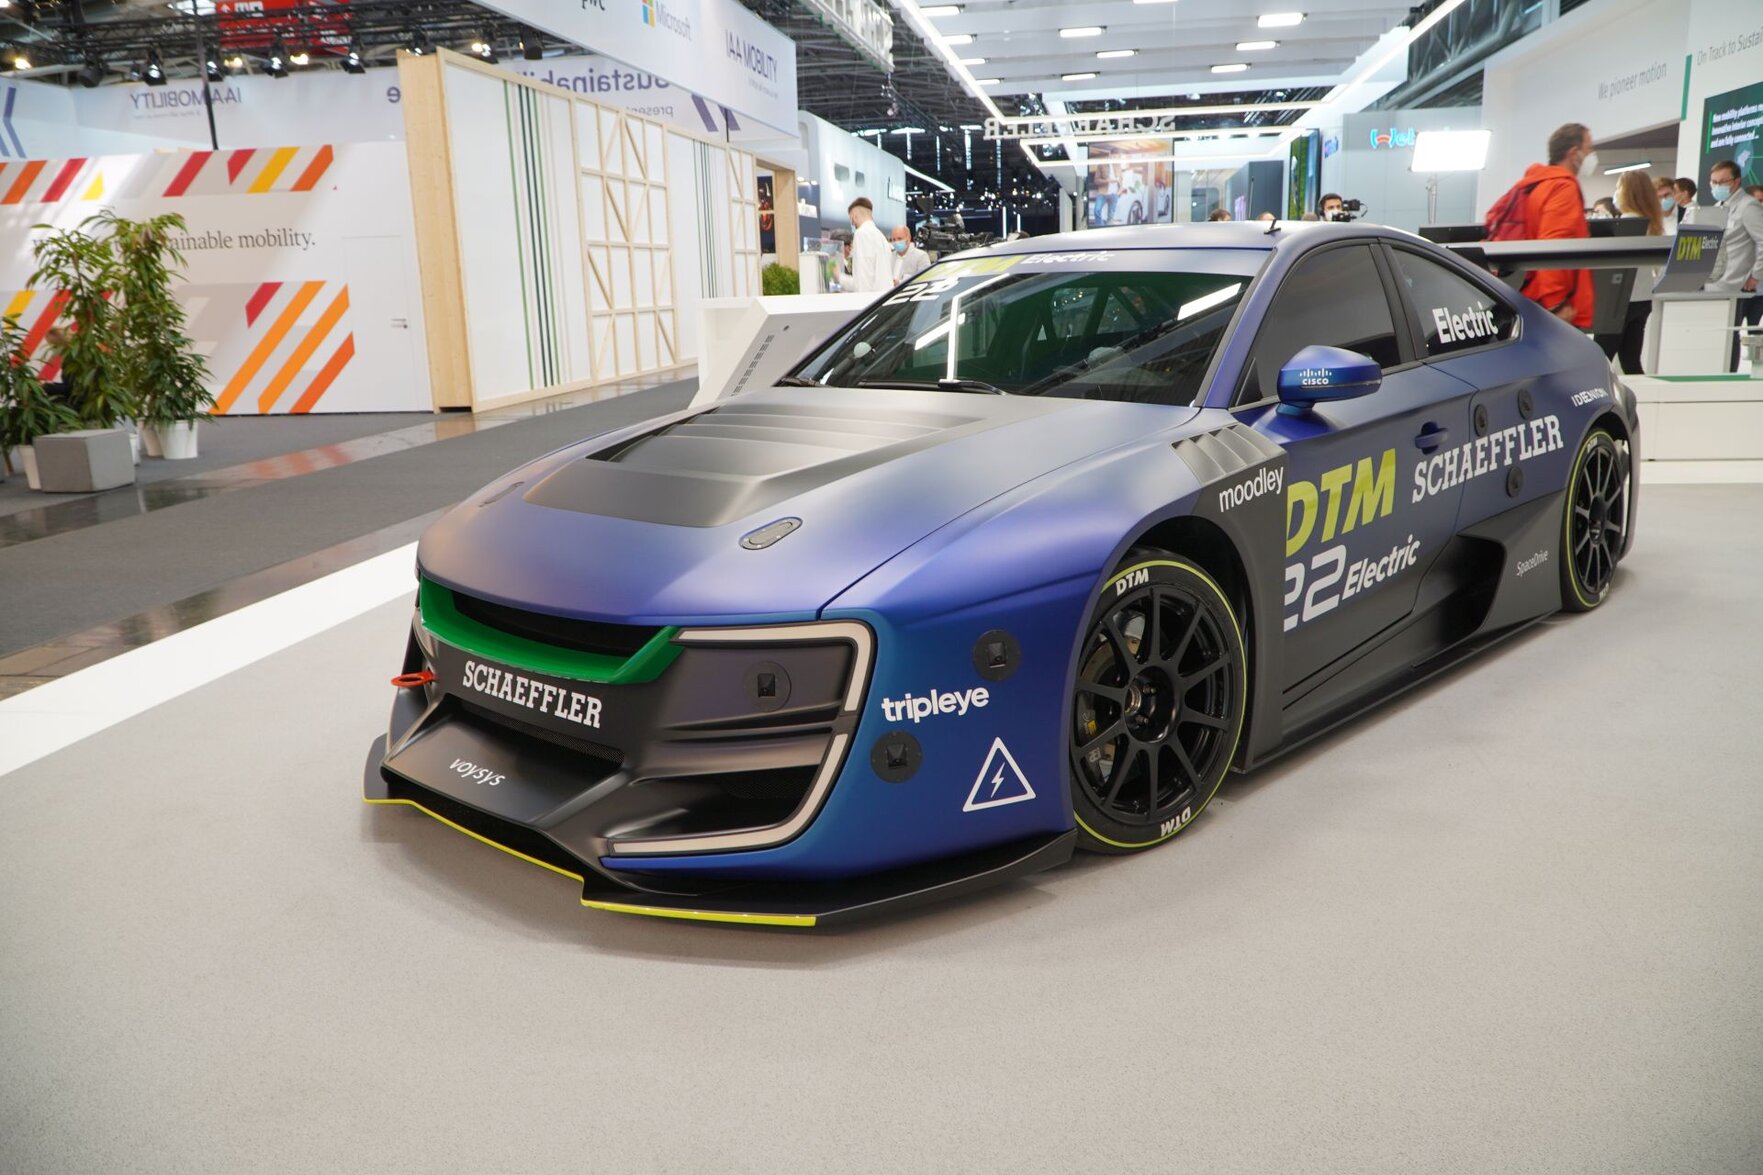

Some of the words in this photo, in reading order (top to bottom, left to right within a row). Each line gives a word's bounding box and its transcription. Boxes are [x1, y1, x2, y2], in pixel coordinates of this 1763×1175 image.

[655, 2, 692, 41] Microsoft
[724, 29, 742, 63] IAA
[742, 41, 778, 83] MOBILITY
[1709, 42, 1727, 60] Track
[1728, 39, 1736, 55] to
[1610, 72, 1637, 101] pioneer
[1639, 60, 1668, 87] motion
[238, 227, 316, 251] mobility.
[1676, 235, 1701, 261] DTM
[1701, 235, 1719, 250] Electric
[1020, 250, 1116, 266] Electric
[1432, 301, 1499, 344] Electric
[1302, 376, 1329, 386] cisco
[1412, 414, 1564, 504] SCHAEFFLER
[1219, 466, 1284, 513] moodley
[1285, 447, 1396, 558] DTM
[1116, 567, 1150, 596] DTM
[1342, 533, 1421, 601] Electric
[1516, 550, 1549, 578] SpaceDrive
[462, 660, 603, 729] SCHAEFFLER
[881, 686, 990, 723] tripleye
[449, 757, 506, 787] voysys
[1160, 805, 1192, 838] DTM
